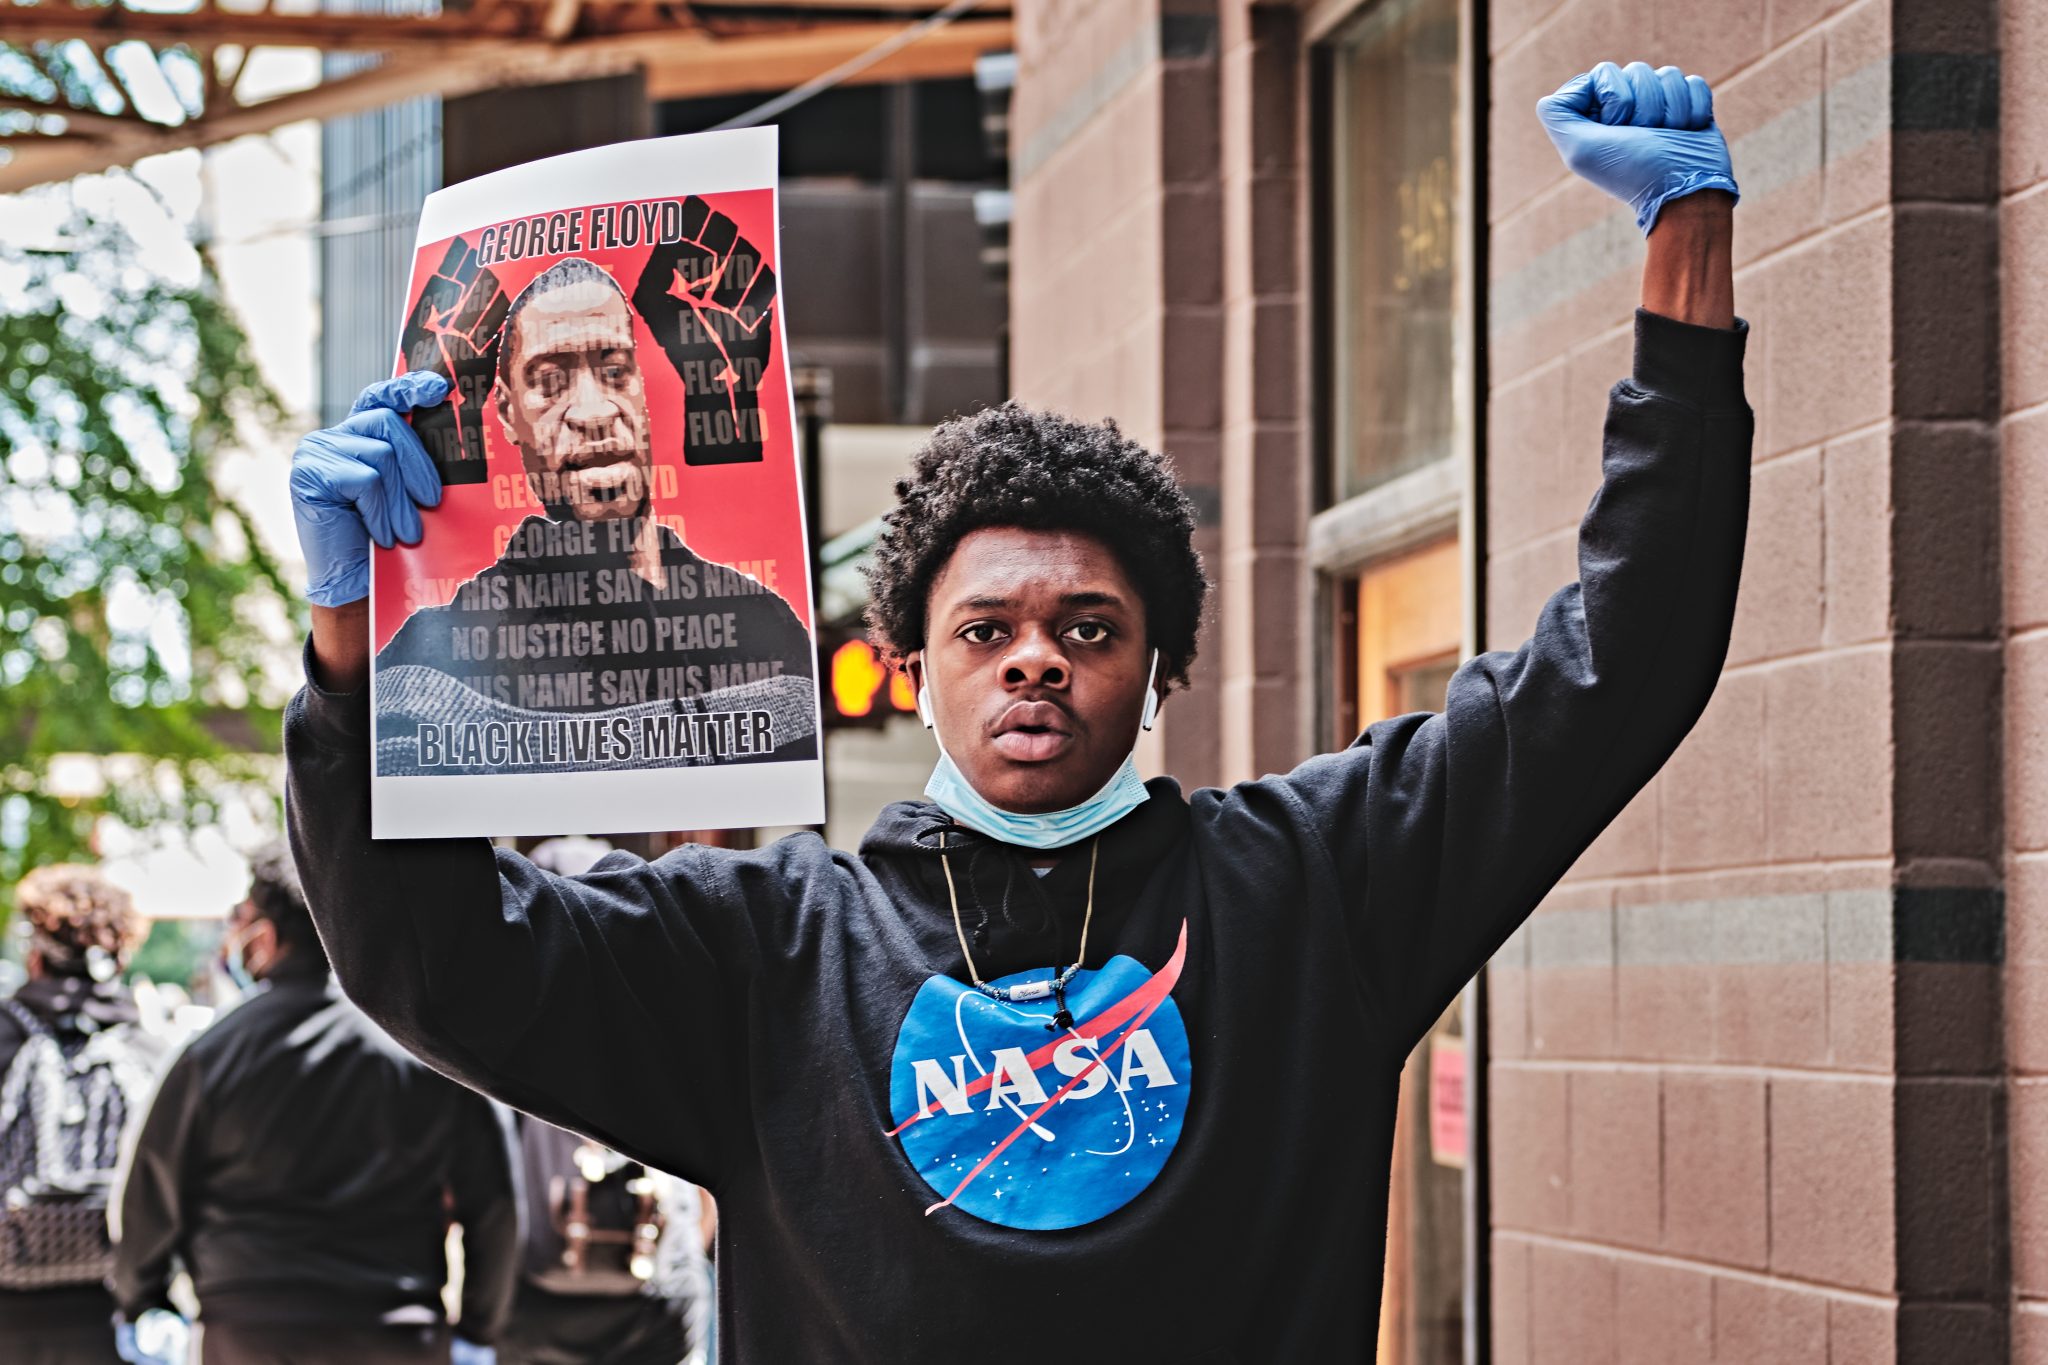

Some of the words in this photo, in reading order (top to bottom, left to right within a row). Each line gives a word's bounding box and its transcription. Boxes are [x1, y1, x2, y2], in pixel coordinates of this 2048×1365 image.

[475, 210, 584, 267] GEORGE
[588, 200, 683, 250] FLOYD
[677, 254, 754, 293] FLOYD
[678, 305, 757, 344] FLOYD
[683, 357, 764, 395] FLOYD
[422, 425, 505, 462] ORGE
[688, 408, 769, 446] FLOYD
[492, 471, 595, 509] GEORGE
[494, 520, 597, 560] GEORGE
[607, 515, 687, 553] FLOYD
[404, 578, 455, 612] SAY
[461, 575, 509, 611] HIS
[516, 571, 591, 608] NAME
[596, 568, 645, 604] SAY
[652, 564, 698, 601] HIS
[703, 559, 780, 598] NAME
[452, 626, 490, 660] NO
[496, 621, 605, 660] JUSTICE
[611, 618, 649, 654] NO
[655, 613, 738, 651] PEACE
[518, 672, 594, 709] NAME
[600, 668, 650, 705] SAY
[657, 665, 703, 701] HIS
[418, 721, 533, 766] BLACK
[539, 716, 634, 764] LIVES
[640, 710, 775, 760] MATTER
[910, 1028, 1178, 1120] NASA
